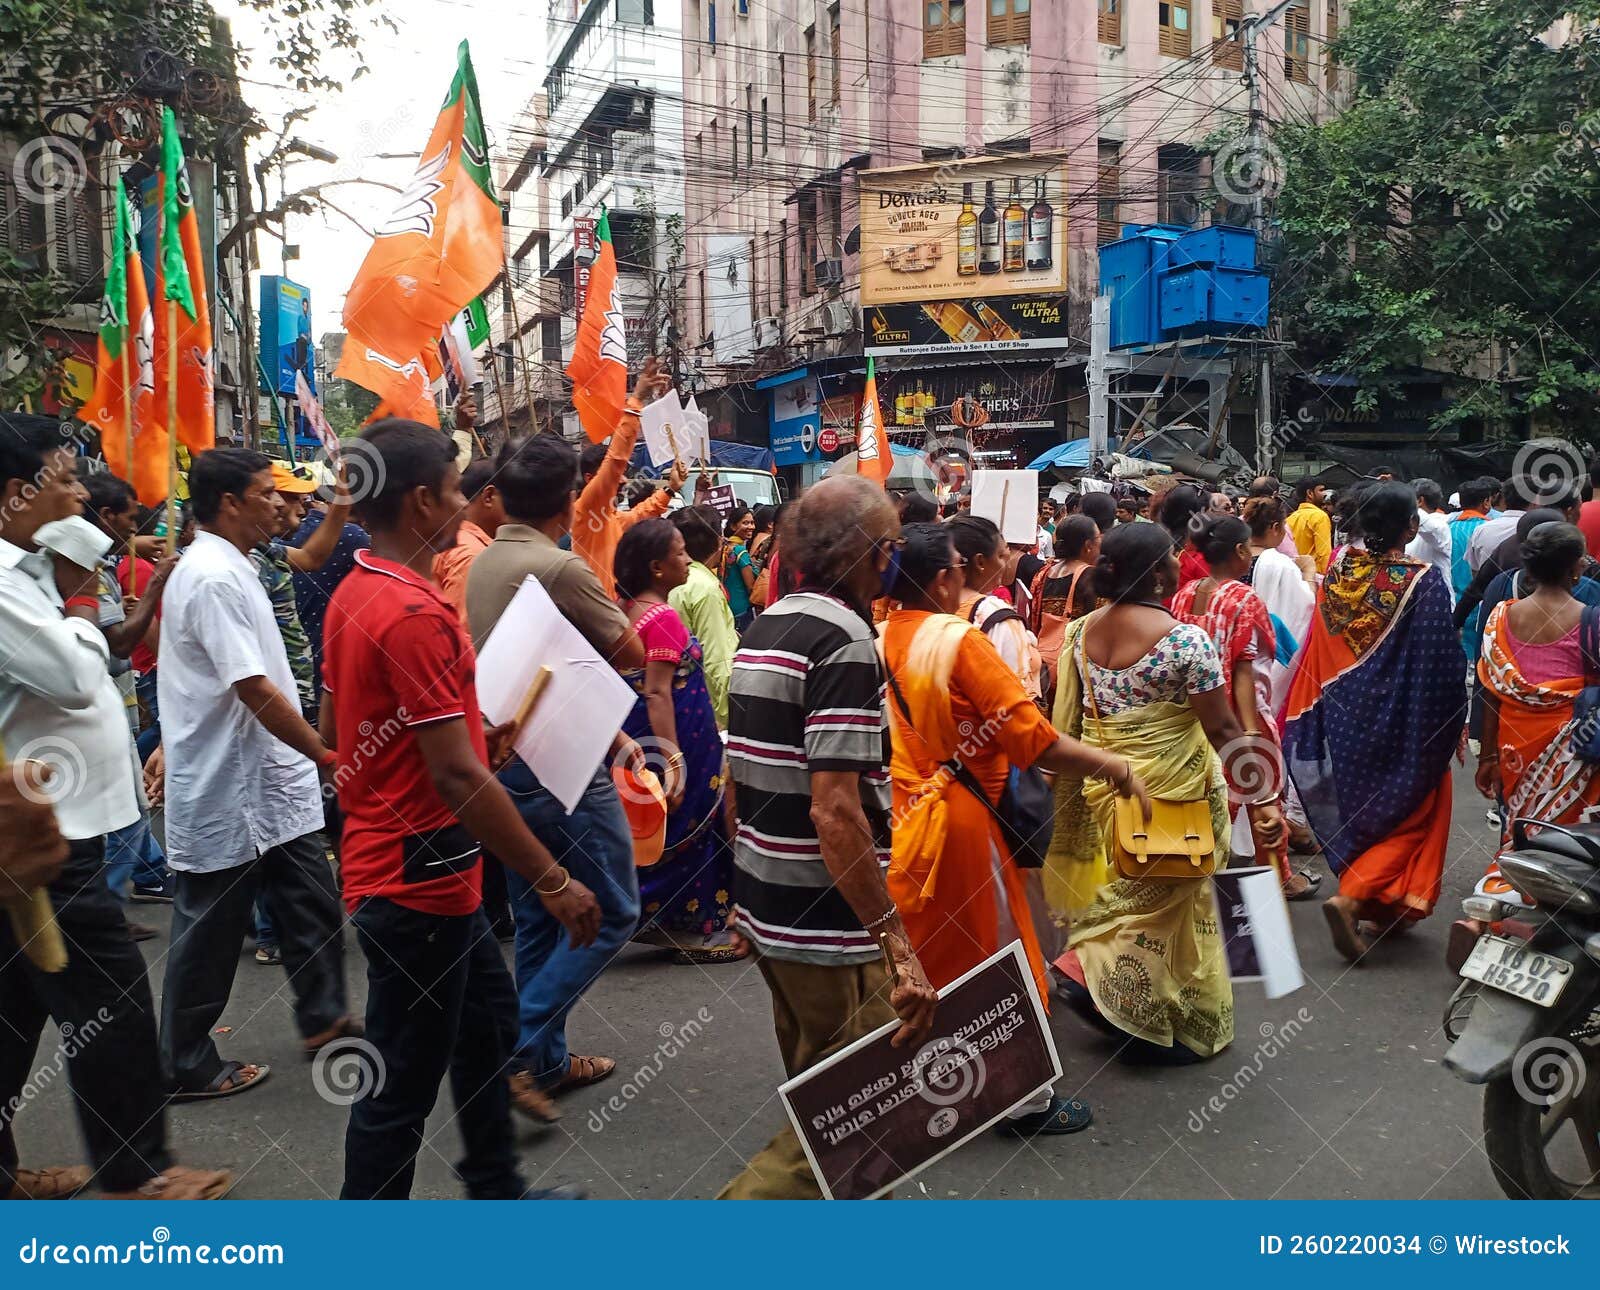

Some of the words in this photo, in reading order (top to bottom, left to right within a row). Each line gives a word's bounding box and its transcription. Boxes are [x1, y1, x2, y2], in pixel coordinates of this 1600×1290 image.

[919, 210, 939, 221] AGED
[1011, 302, 1030, 310] LIVE
[1032, 301, 1048, 309] THE
[1022, 308, 1059, 318] ULTRA
[1040, 316, 1061, 324] LIFE
[878, 333, 907, 341] ULTRA
[930, 344, 961, 352] Dadabhoy
[1529, 956, 1560, 979] 07
[952, 992, 1020, 1046] যোগ্যদের
[901, 1040, 951, 1079] চাকরি
[847, 1071, 898, 1109] ফেরত
[811, 1104, 847, 1131] দাও
